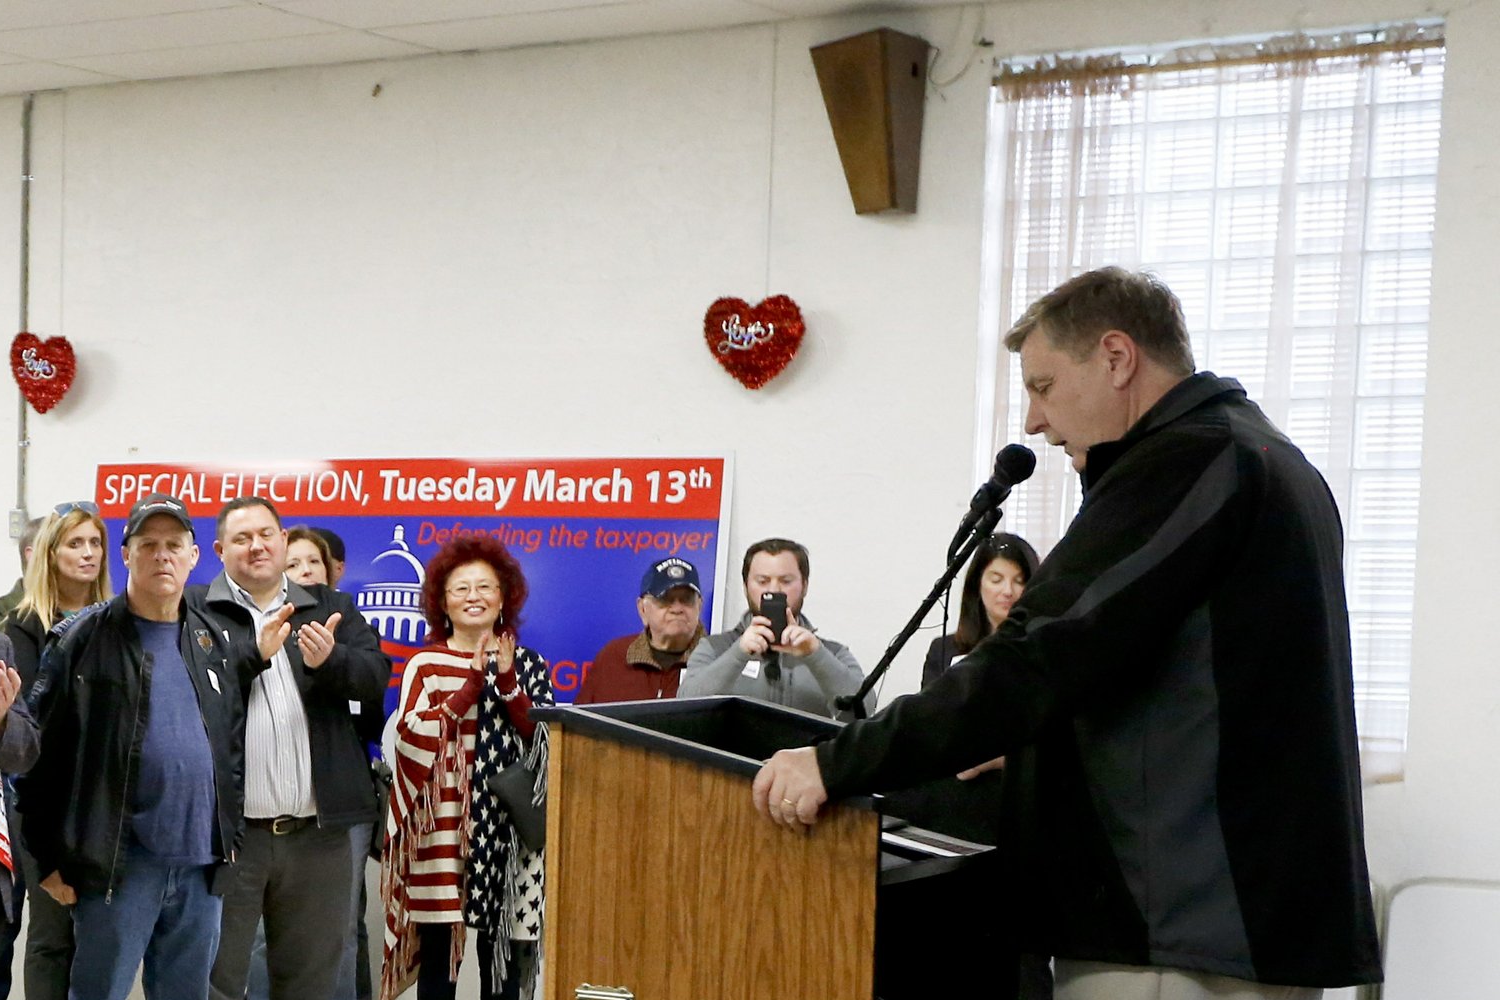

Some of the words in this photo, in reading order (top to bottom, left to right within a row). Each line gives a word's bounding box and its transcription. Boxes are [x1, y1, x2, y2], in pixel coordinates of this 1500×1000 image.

[103, 472, 212, 504] SPECIAL
[219, 468, 370, 506] ELECTION,
[379, 468, 516, 510] Tuesday
[522, 468, 632, 504] March
[645, 467, 712, 504] 13th
[548, 523, 590, 549] the
[594, 527, 713, 555] taxpayer
